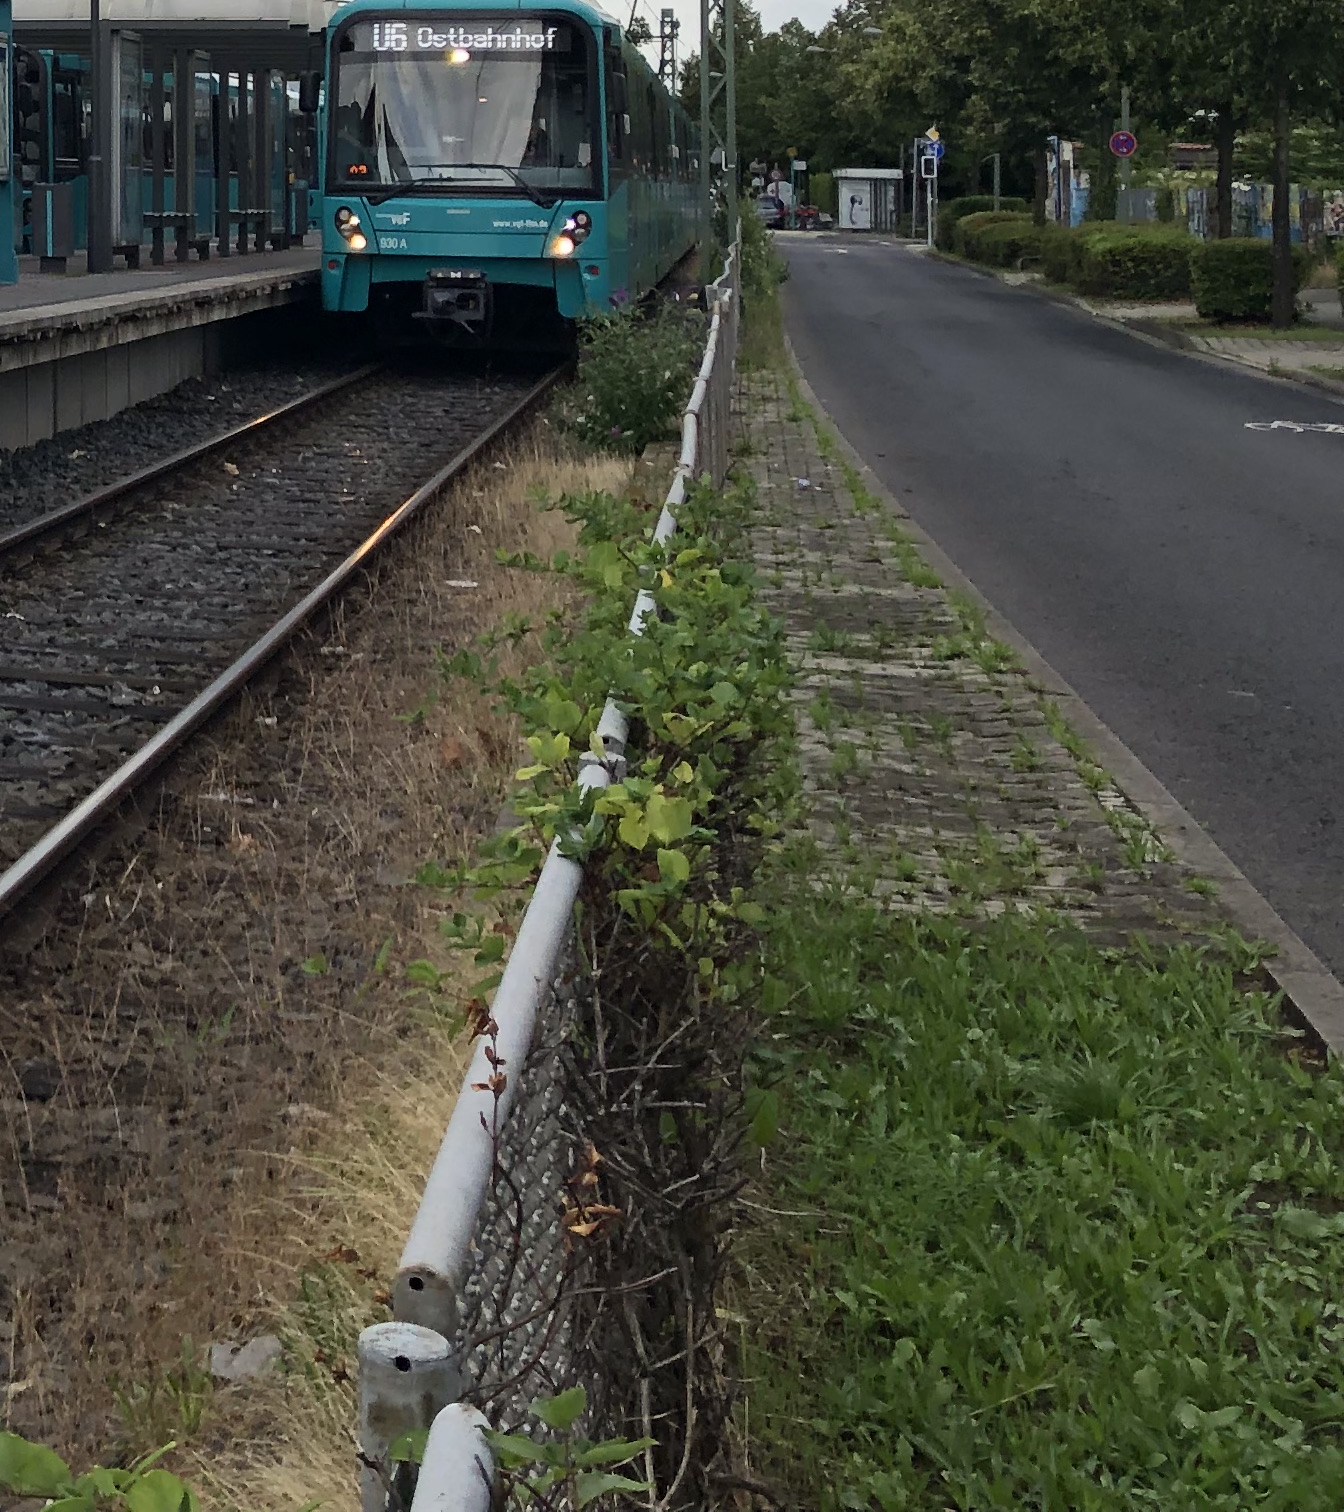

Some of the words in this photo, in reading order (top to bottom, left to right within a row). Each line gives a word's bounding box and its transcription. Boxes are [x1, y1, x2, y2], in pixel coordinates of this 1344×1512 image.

[373, 23, 408, 51] U6
[417, 27, 558, 49] Ostbahnhof
[399, 239, 408, 249] A
